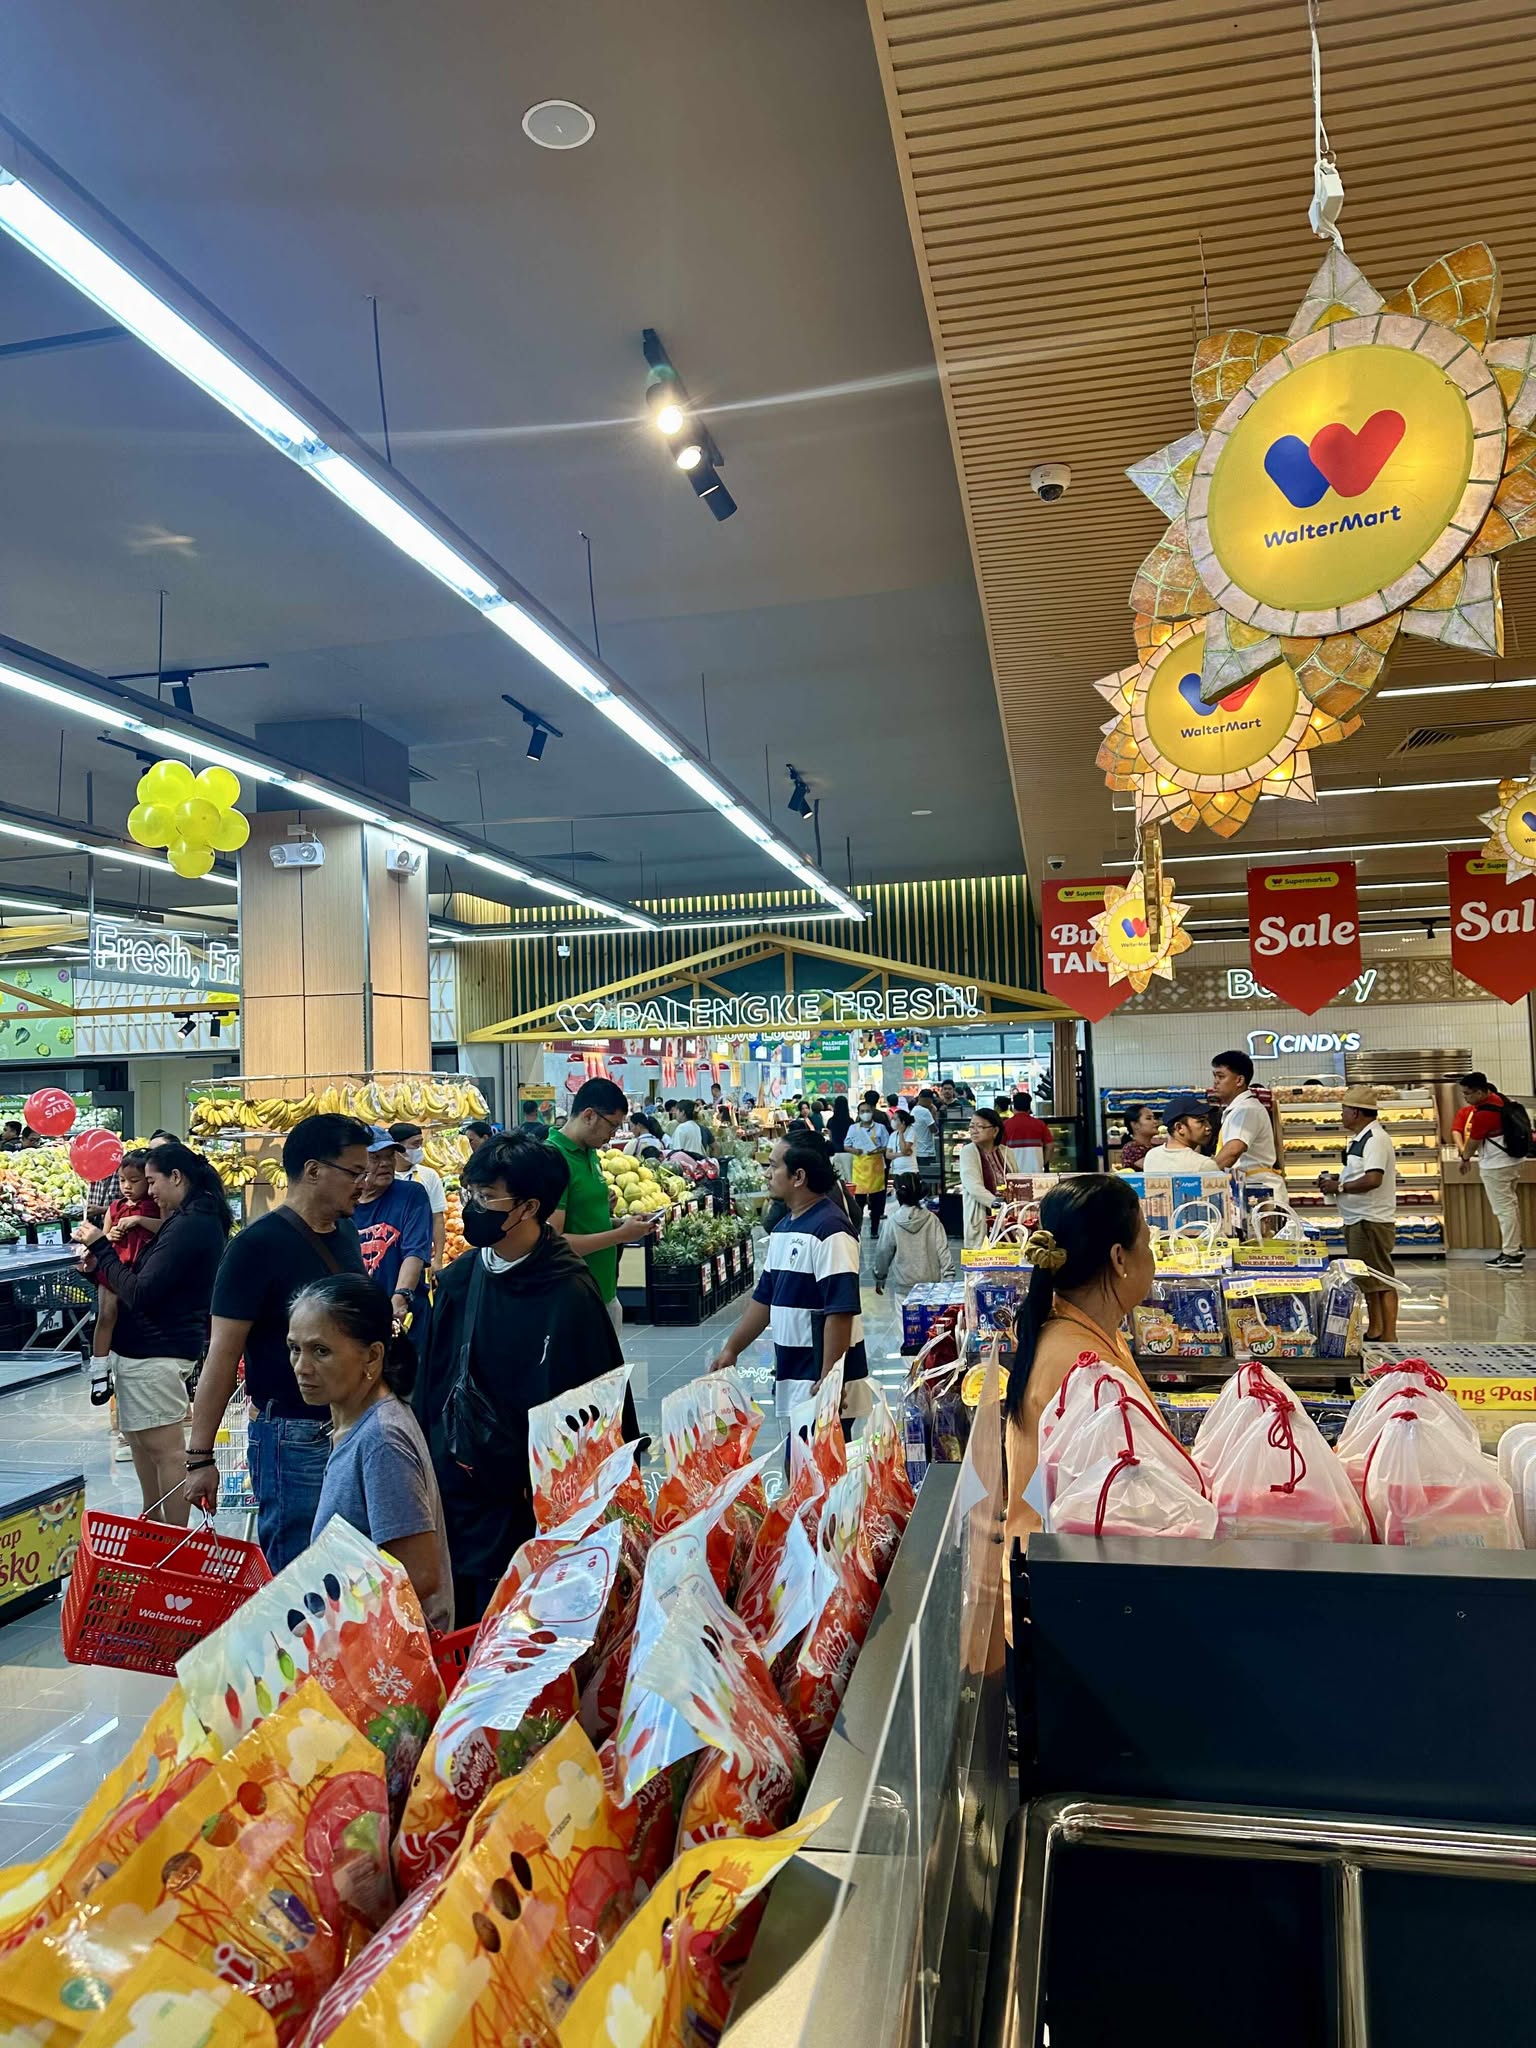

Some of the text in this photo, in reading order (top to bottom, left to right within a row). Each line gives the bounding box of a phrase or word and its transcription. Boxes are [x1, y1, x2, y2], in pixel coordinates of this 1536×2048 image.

[1263, 505, 1402, 548] WalterMart
[1180, 718, 1262, 738] WalterMart
[1284, 876, 1332, 885] Supermarket
[1076, 889, 1104, 898] Superm
[1455, 898, 1536, 942] Sal
[1050, 923, 1097, 946] Bu
[1254, 913, 1355, 956] Sale
[95, 924, 240, 987] Fresh, Fr
[1048, 951, 1106, 974] TAK
[617, 984, 978, 1032] PALENGKE FRESH!
[45, 1102, 71, 1119] SALE
[1197, 1298, 1218, 1333] ORE
[1149, 1339, 1171, 1352] TANG
[1251, 1339, 1274, 1354] TANG
[1462, 1388, 1486, 1404] ng
[1490, 1386, 1536, 1402] Pas
[0, 1551, 40, 1587] sko
[139, 1608, 203, 1627] WalterMart
